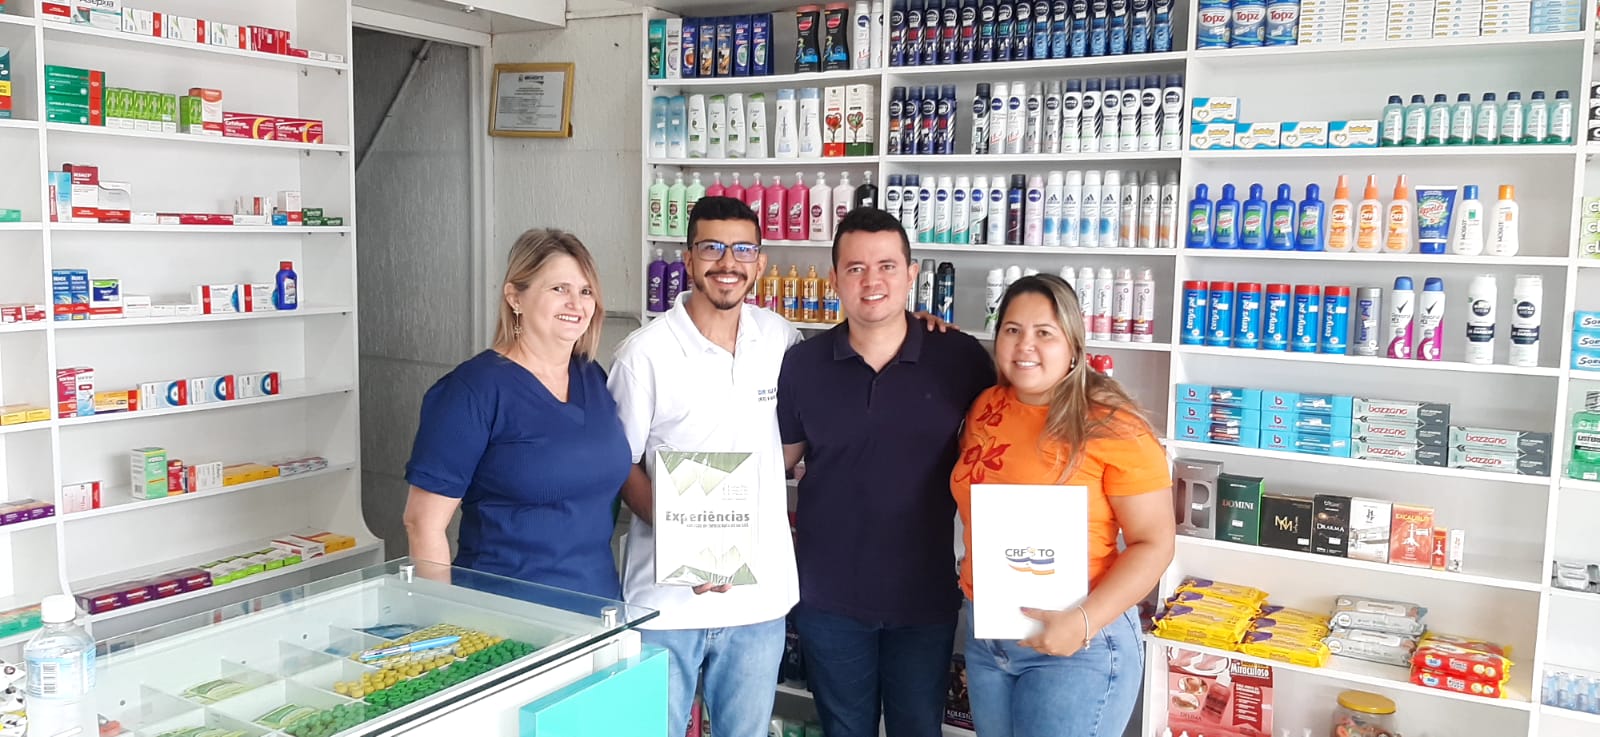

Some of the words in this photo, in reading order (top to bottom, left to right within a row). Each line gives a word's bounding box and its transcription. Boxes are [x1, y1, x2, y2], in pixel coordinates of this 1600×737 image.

[1202, 13, 1225, 24] Topz
[1236, 11, 1260, 22] Topz
[1270, 10, 1294, 22] Topz
[1368, 404, 1408, 415] bozzano
[1367, 424, 1407, 436] bozzano
[1465, 433, 1507, 444] bozzano
[1465, 454, 1502, 465] bozzan
[1221, 498, 1255, 511] DOMINI
[665, 510, 750, 525] Experiências
[1230, 661, 1270, 678] Miraculoso
